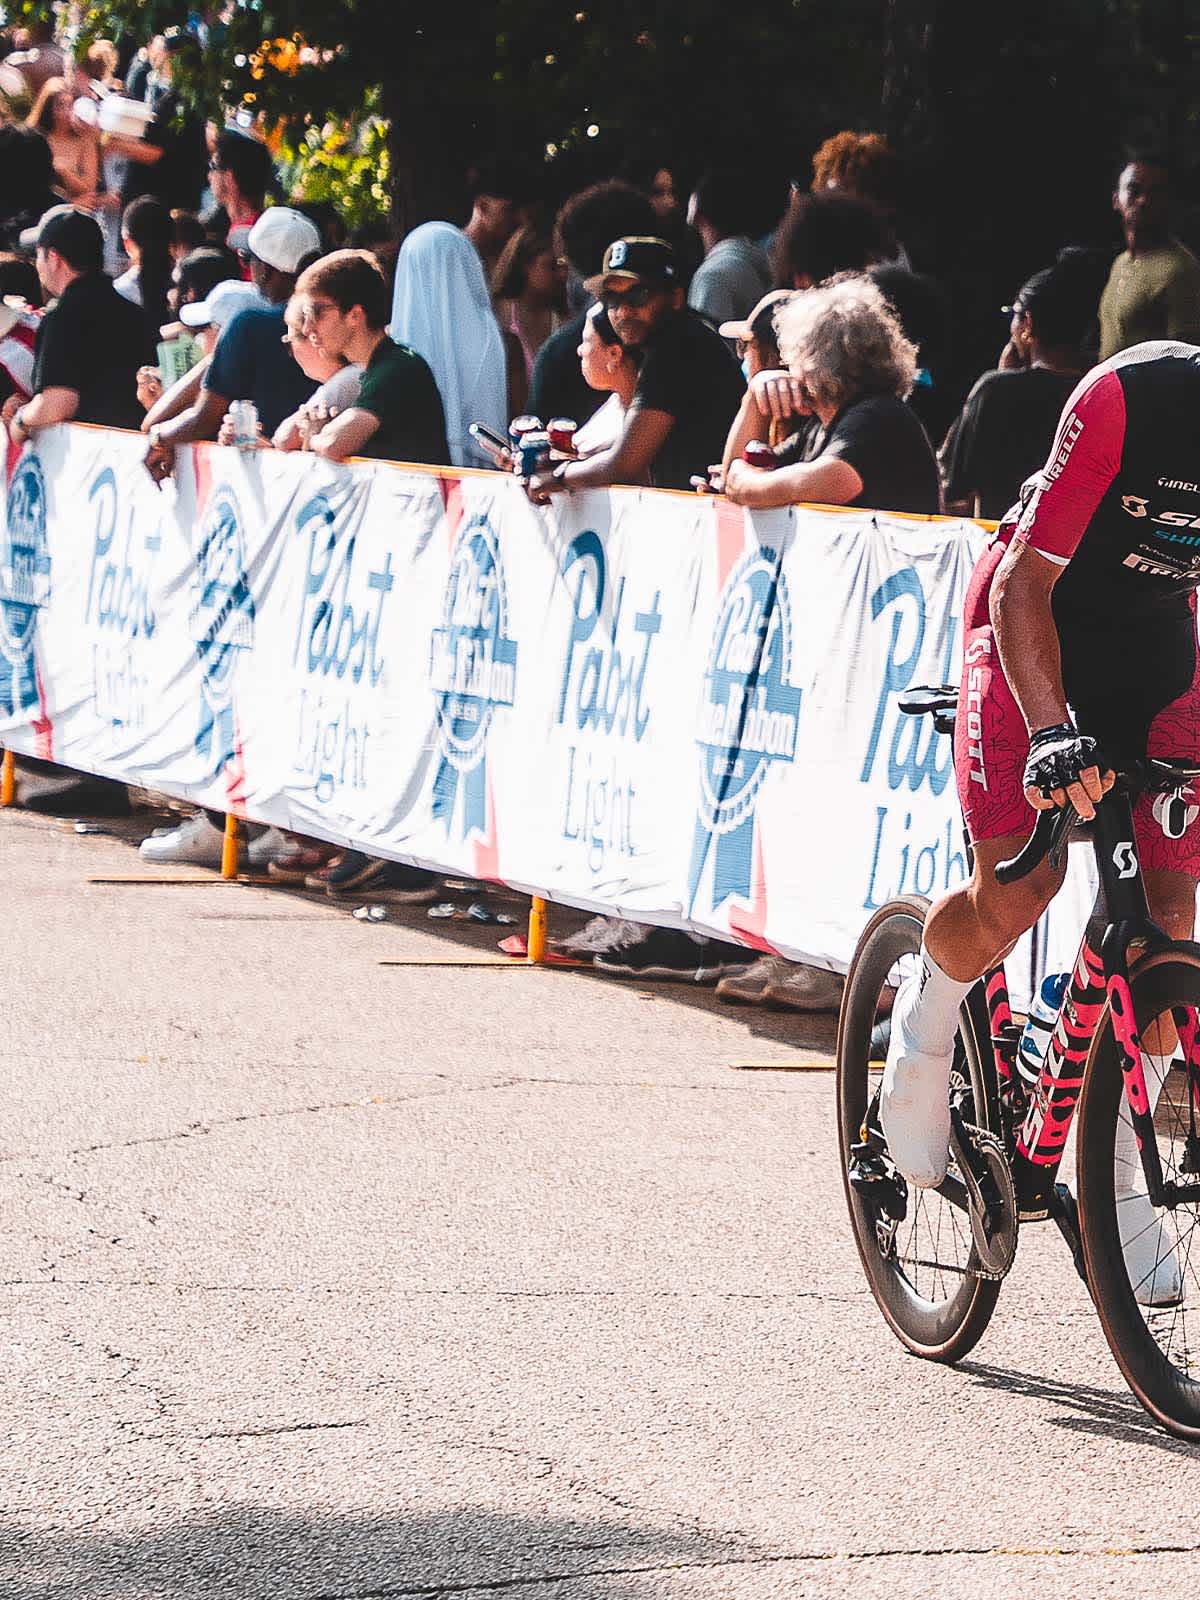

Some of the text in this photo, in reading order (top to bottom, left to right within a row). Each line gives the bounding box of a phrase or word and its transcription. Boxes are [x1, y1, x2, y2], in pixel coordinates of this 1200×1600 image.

[556, 529, 662, 742] Pabst
[859, 566, 958, 797] Pab
[967, 667, 988, 792] SCOTT
[562, 746, 637, 874] Light
[863, 807, 965, 910] Ligh
